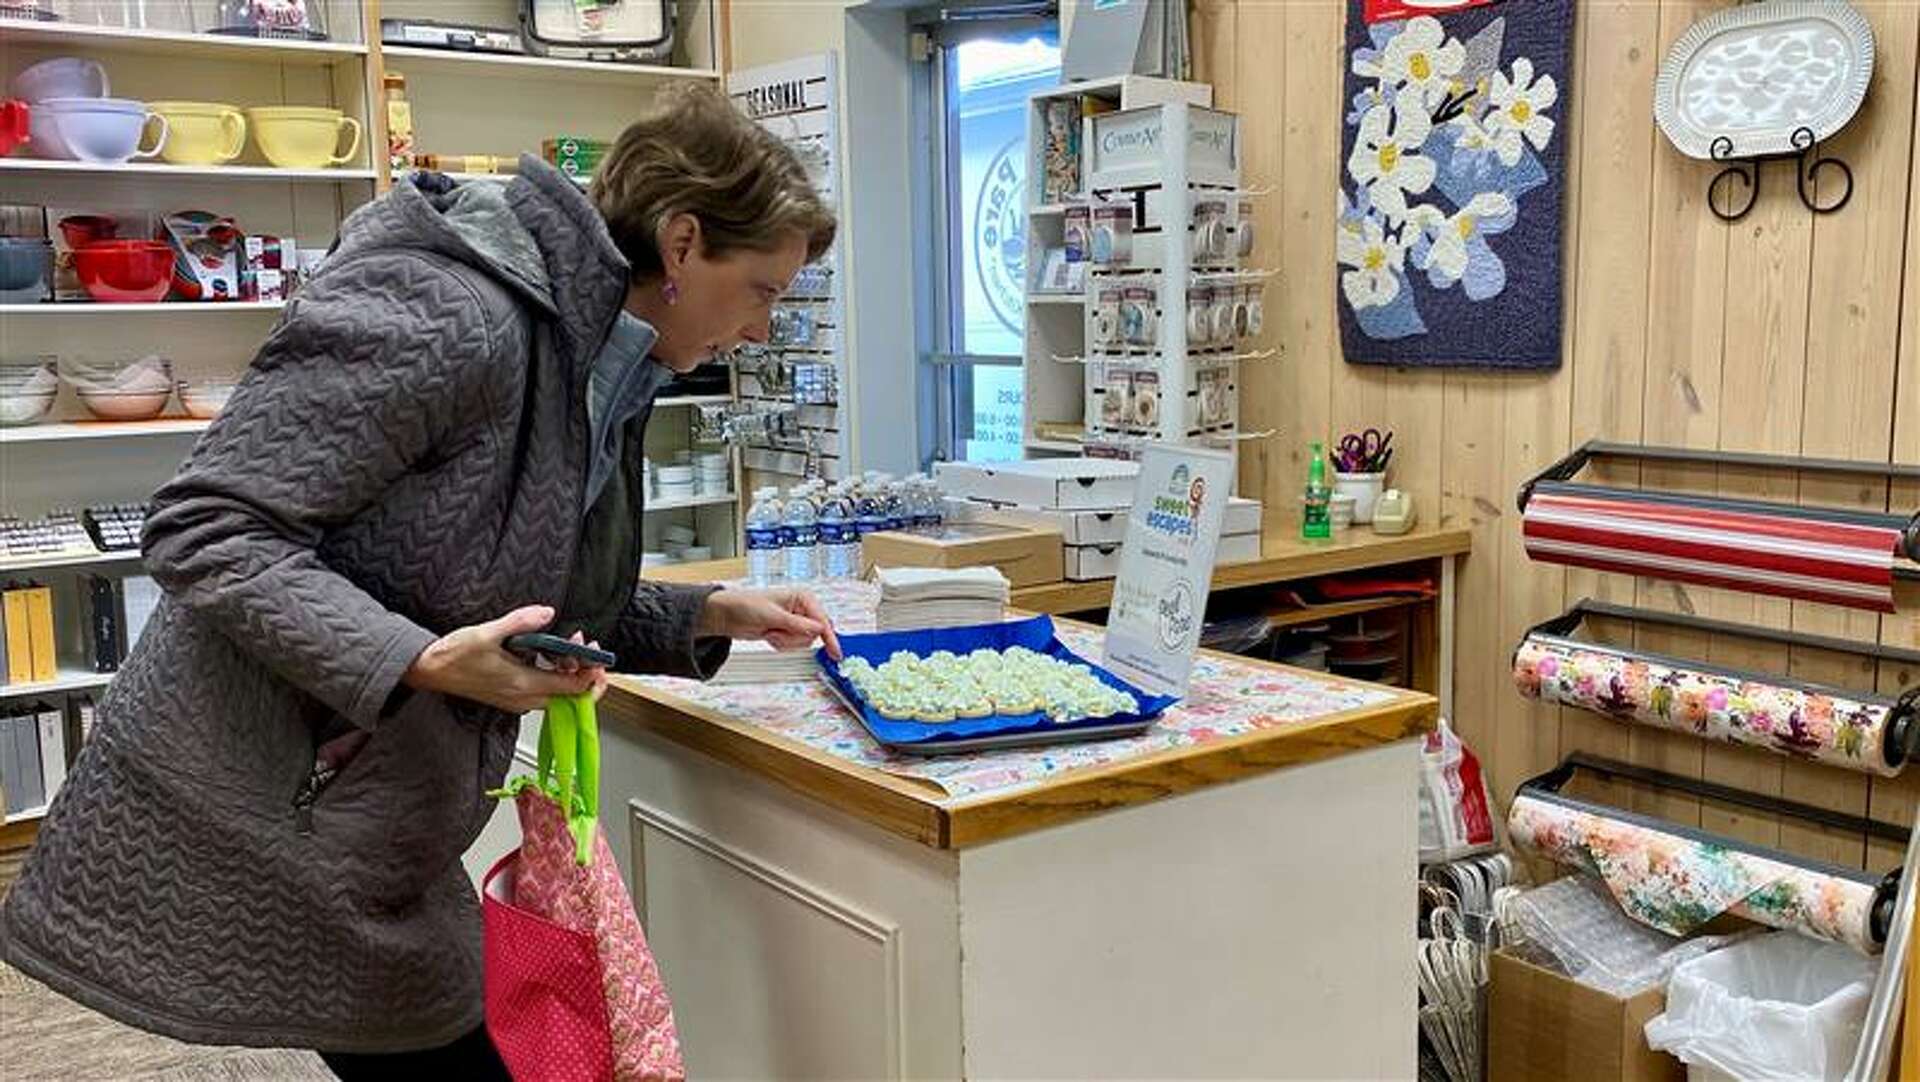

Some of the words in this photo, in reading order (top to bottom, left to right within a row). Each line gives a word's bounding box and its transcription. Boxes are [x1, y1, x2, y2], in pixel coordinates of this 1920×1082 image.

[746, 80, 806, 117] SEASONAL
[1154, 496, 1190, 517] sweet
[1146, 511, 1192, 537] escapes
